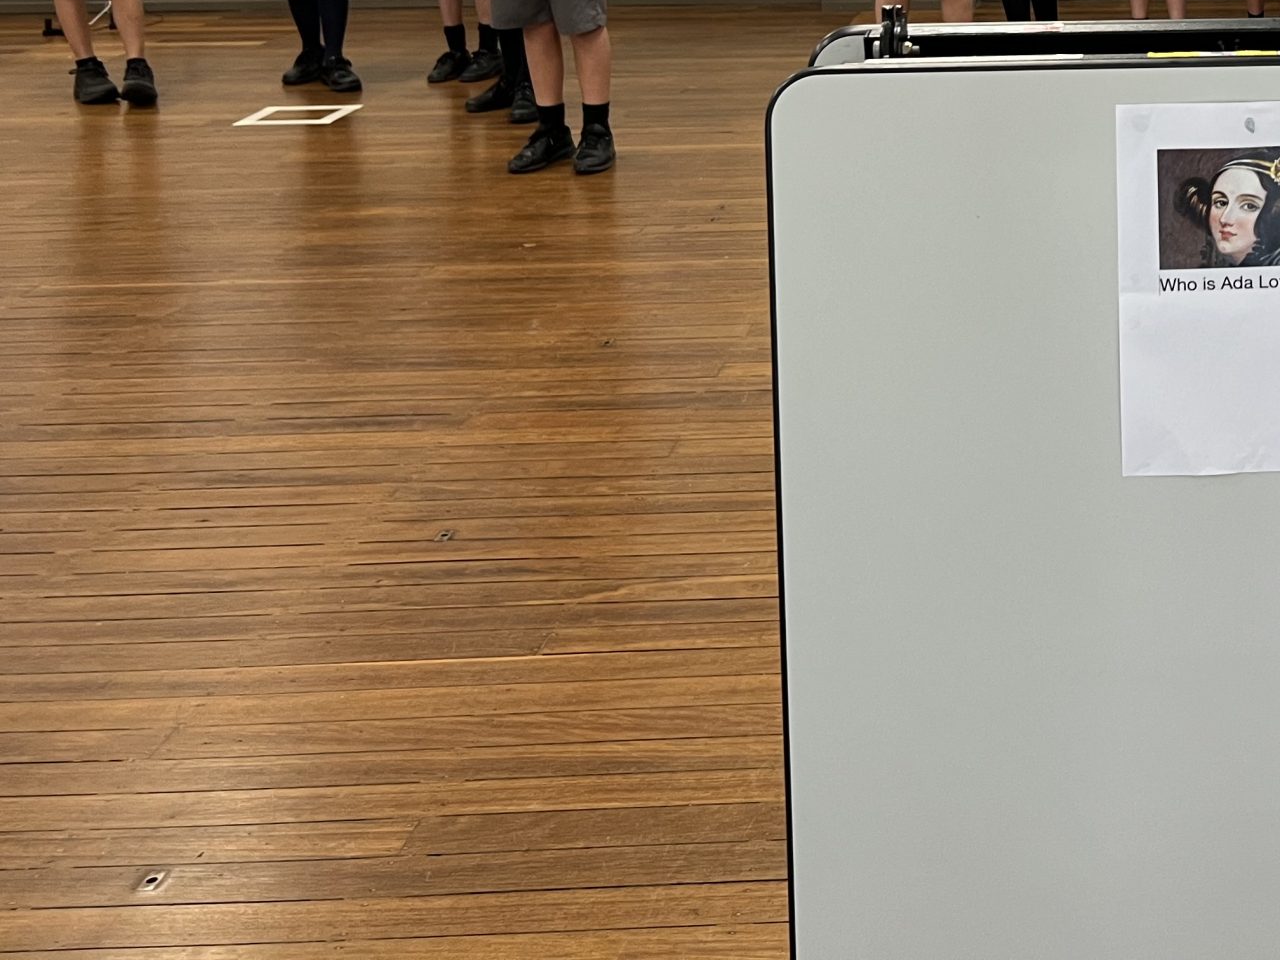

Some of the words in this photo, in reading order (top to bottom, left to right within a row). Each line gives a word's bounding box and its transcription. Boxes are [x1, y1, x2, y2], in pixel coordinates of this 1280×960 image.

[1160, 276, 1198, 292] Who
[1203, 275, 1217, 291] is
[1221, 274, 1254, 291] Ada
